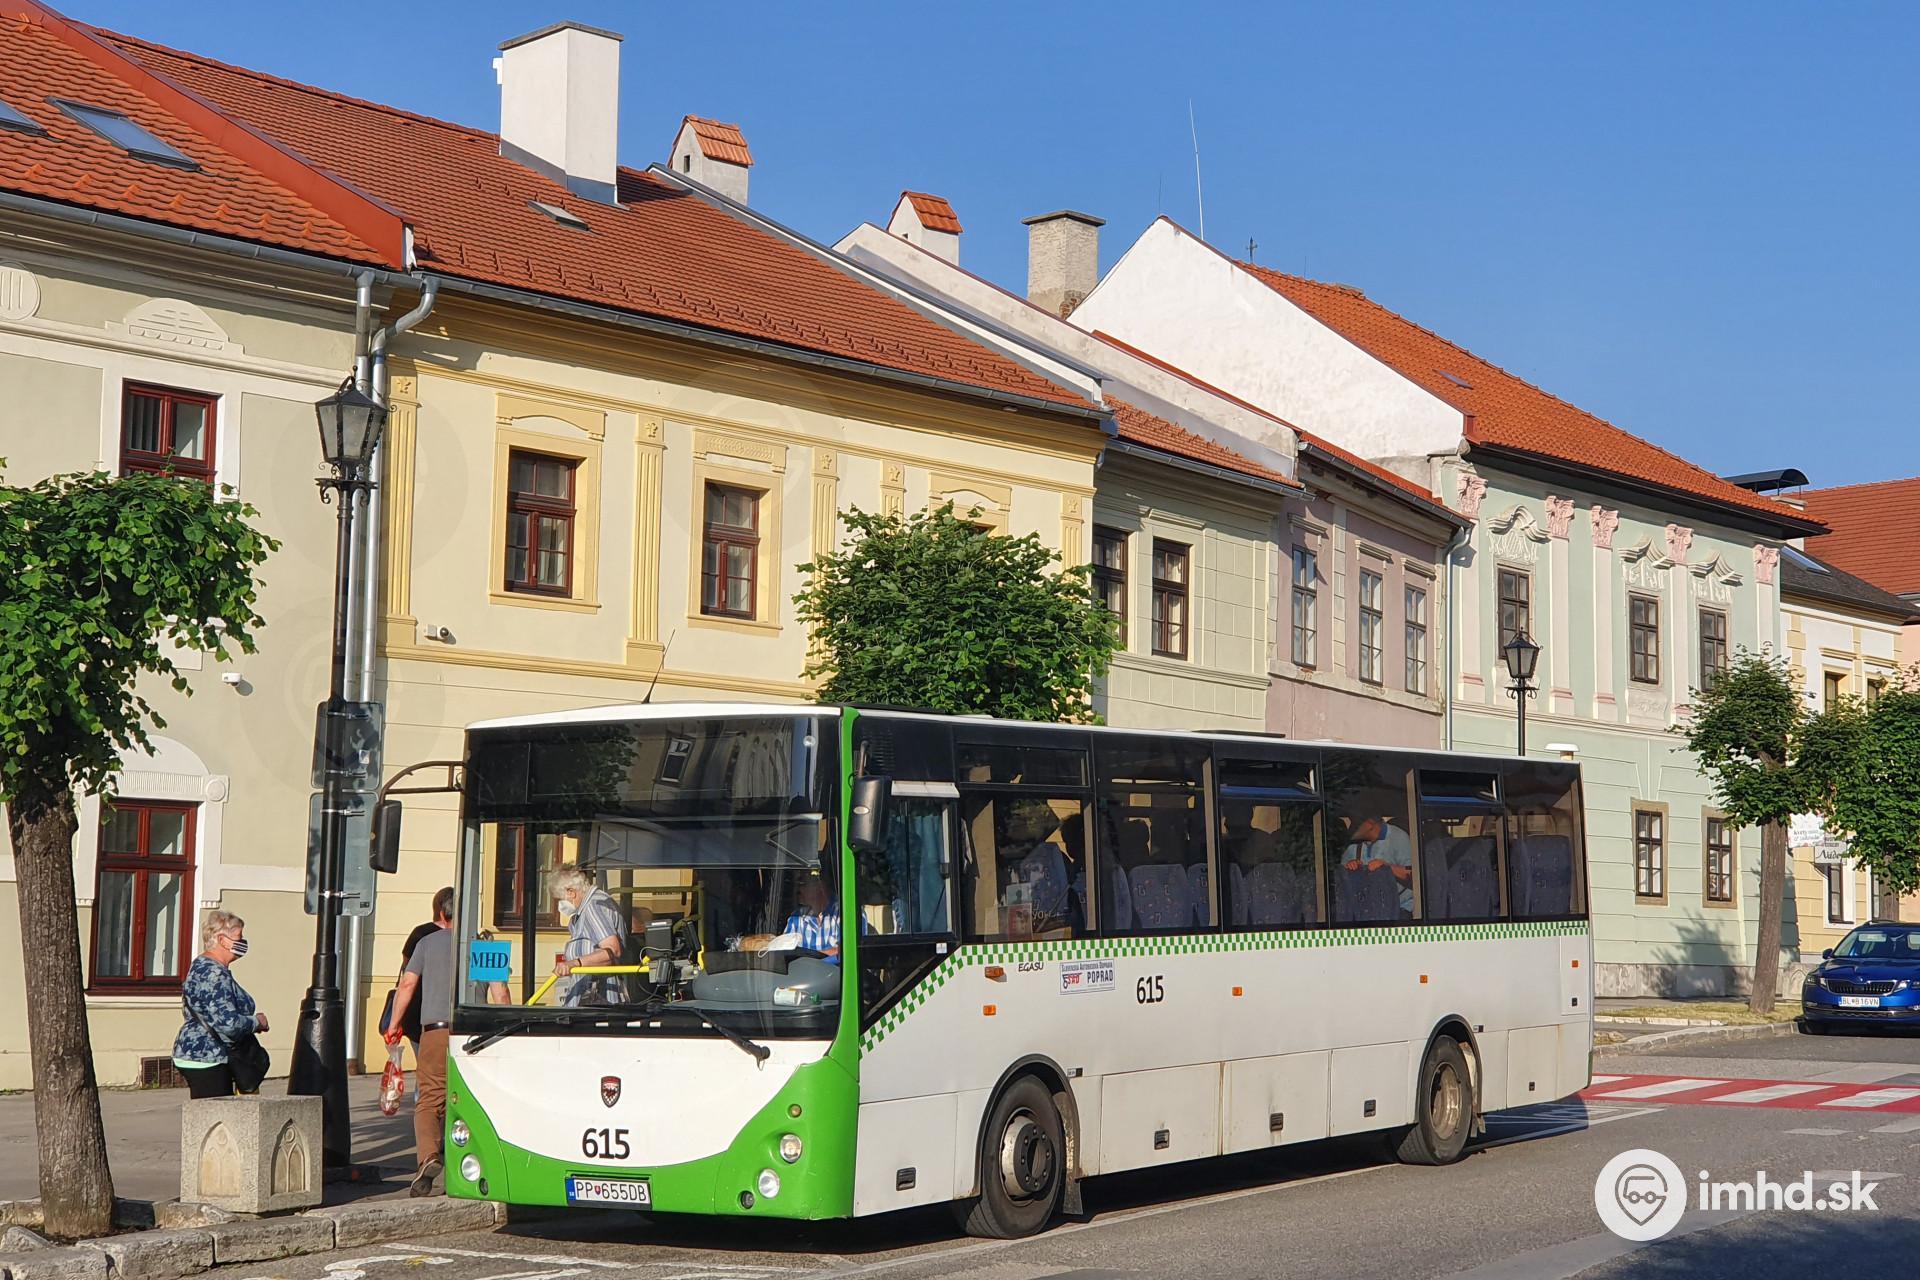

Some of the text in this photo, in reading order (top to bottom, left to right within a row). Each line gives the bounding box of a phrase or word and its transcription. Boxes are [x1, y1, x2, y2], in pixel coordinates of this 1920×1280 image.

[471, 951, 509, 969] MHD
[1087, 969, 1114, 984] POPRAD
[1136, 975, 1164, 1003] 615
[582, 1128, 631, 1160] 615
